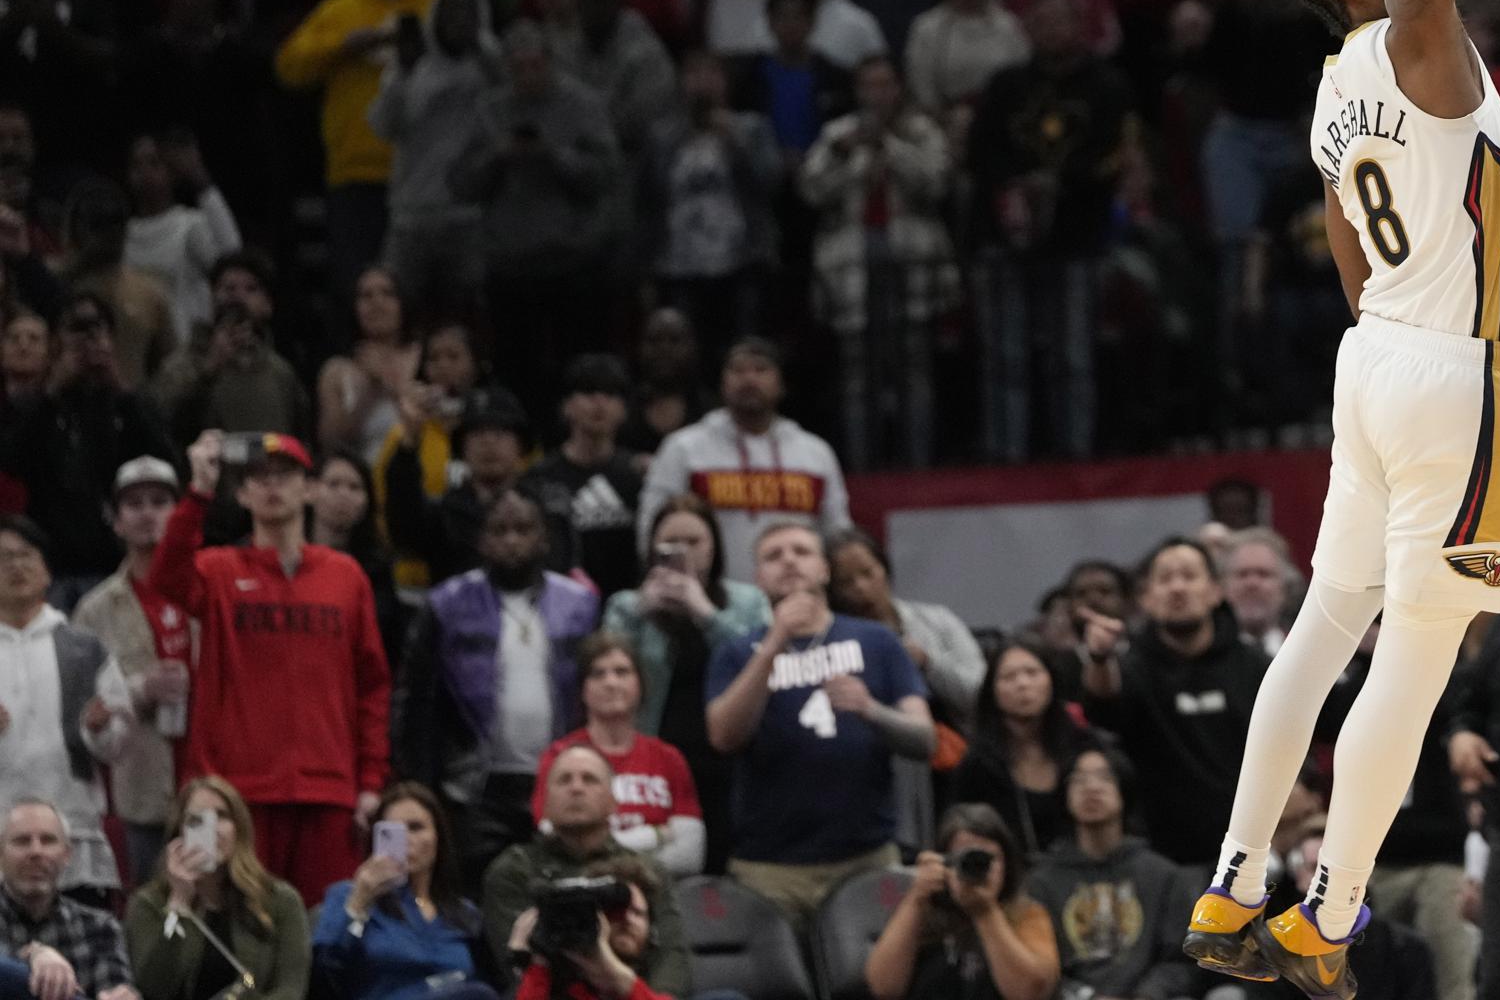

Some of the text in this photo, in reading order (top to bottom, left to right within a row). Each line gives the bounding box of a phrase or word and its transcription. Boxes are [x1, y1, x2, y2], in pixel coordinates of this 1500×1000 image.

[1320, 99, 1407, 190] MARSHALL
[1353, 157, 1412, 269] 8
[798, 688, 838, 739] 4
